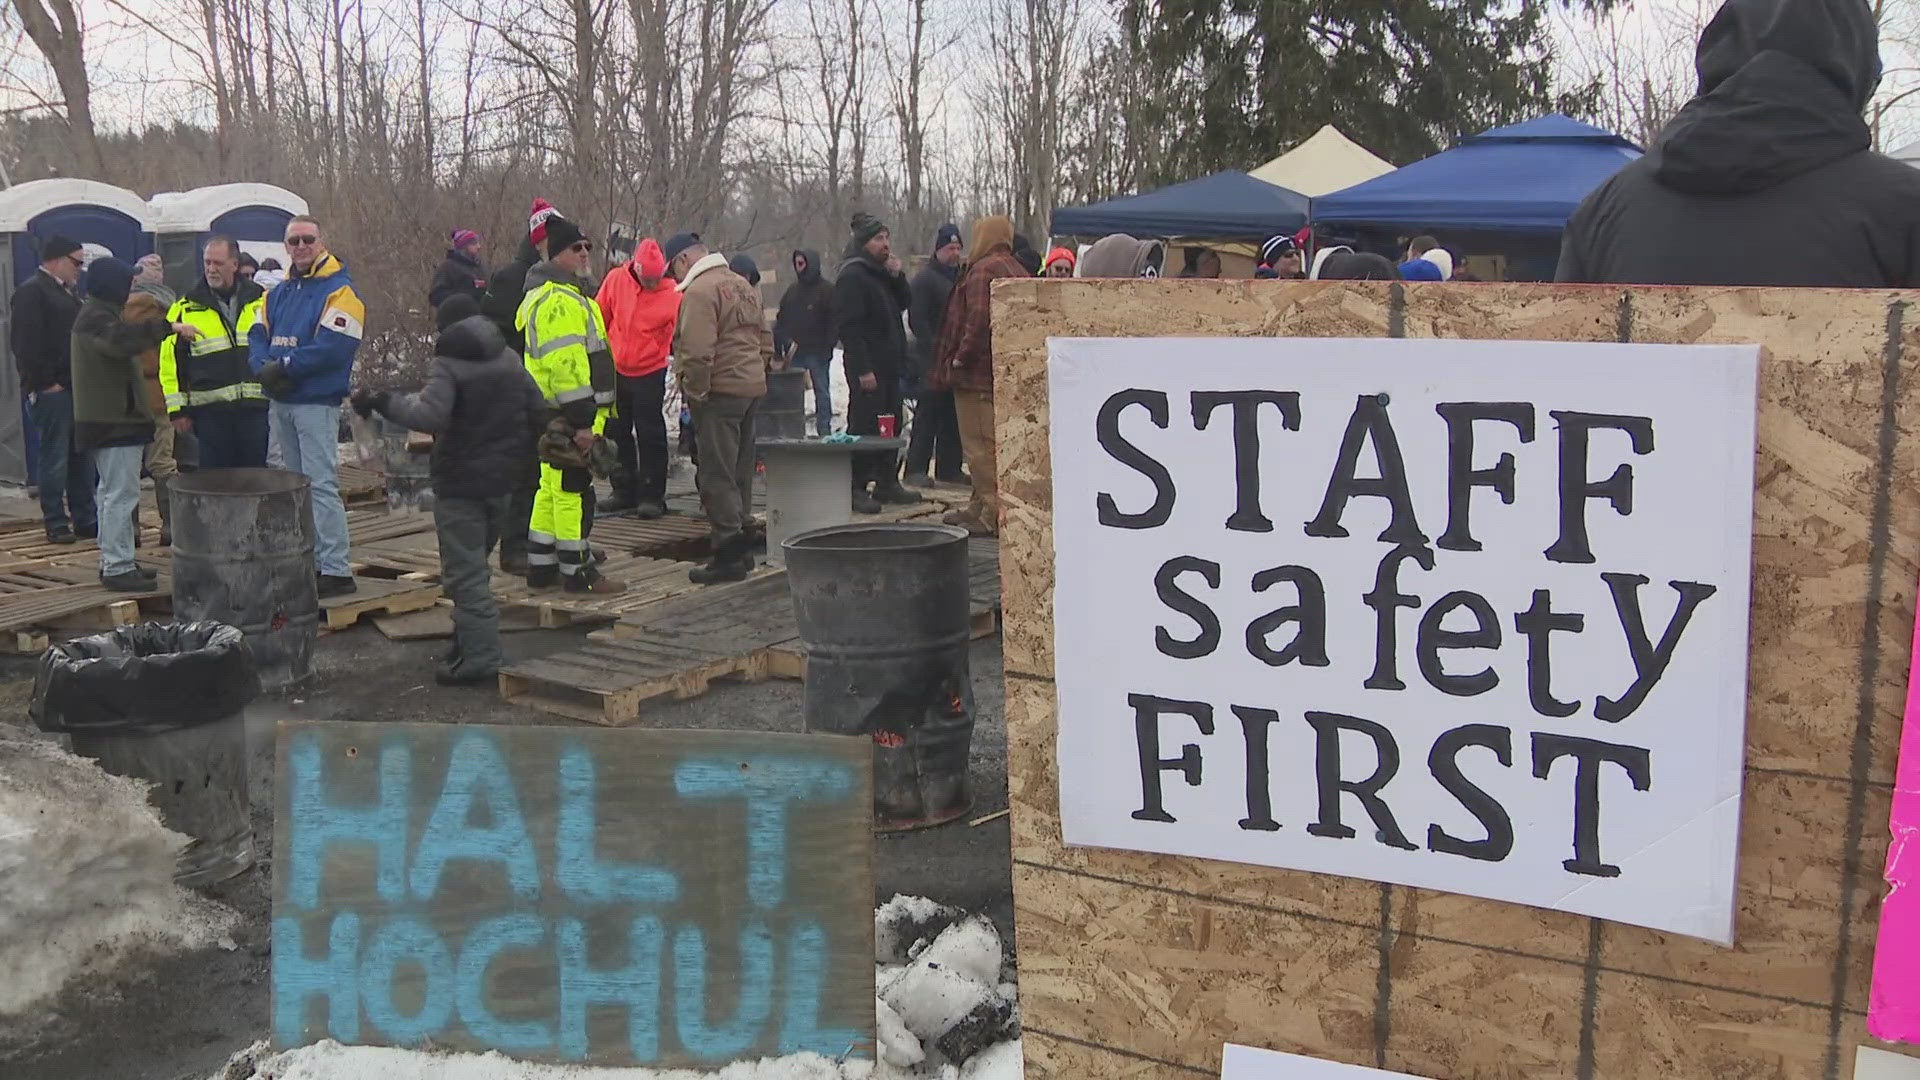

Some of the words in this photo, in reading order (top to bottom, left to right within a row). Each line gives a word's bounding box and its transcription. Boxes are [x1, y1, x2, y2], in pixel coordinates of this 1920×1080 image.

[1096, 388, 1655, 564] STAFF
[1154, 545, 1718, 724] safety
[287, 733, 855, 909] HALT
[1128, 692, 1651, 877] FIRST
[272, 912, 872, 1064] HOCHUL
